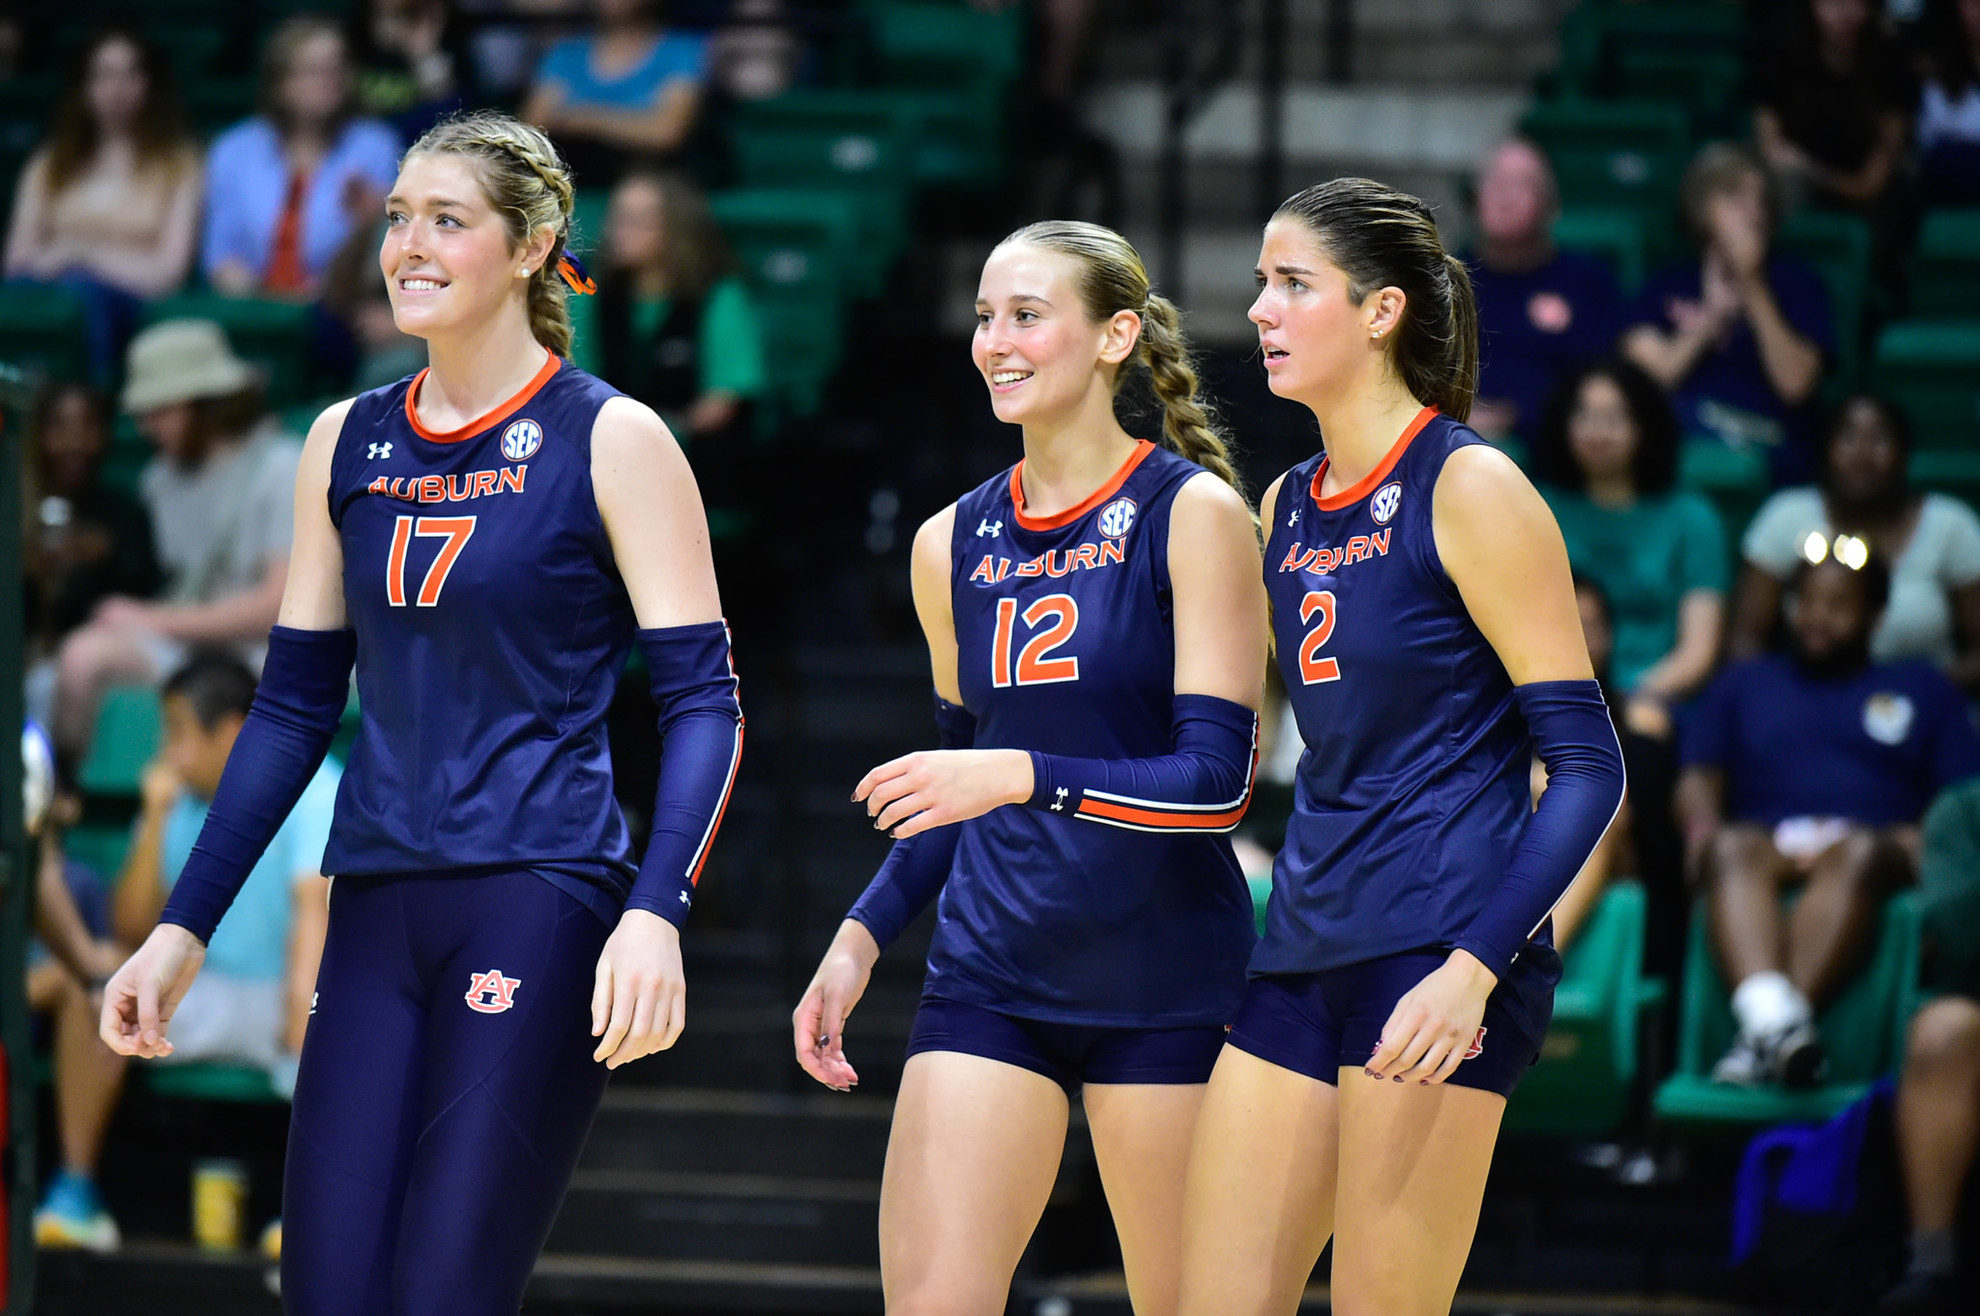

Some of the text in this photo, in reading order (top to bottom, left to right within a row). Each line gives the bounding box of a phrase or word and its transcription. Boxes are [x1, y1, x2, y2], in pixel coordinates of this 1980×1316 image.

[504, 422, 540, 459] SEC
[368, 464, 528, 503] AUBURN
[1101, 500, 1137, 537] SEC
[1373, 484, 1401, 523] SEC
[386, 515, 477, 607] 17
[991, 593, 1079, 688] 12
[1298, 590, 1341, 686] 2
